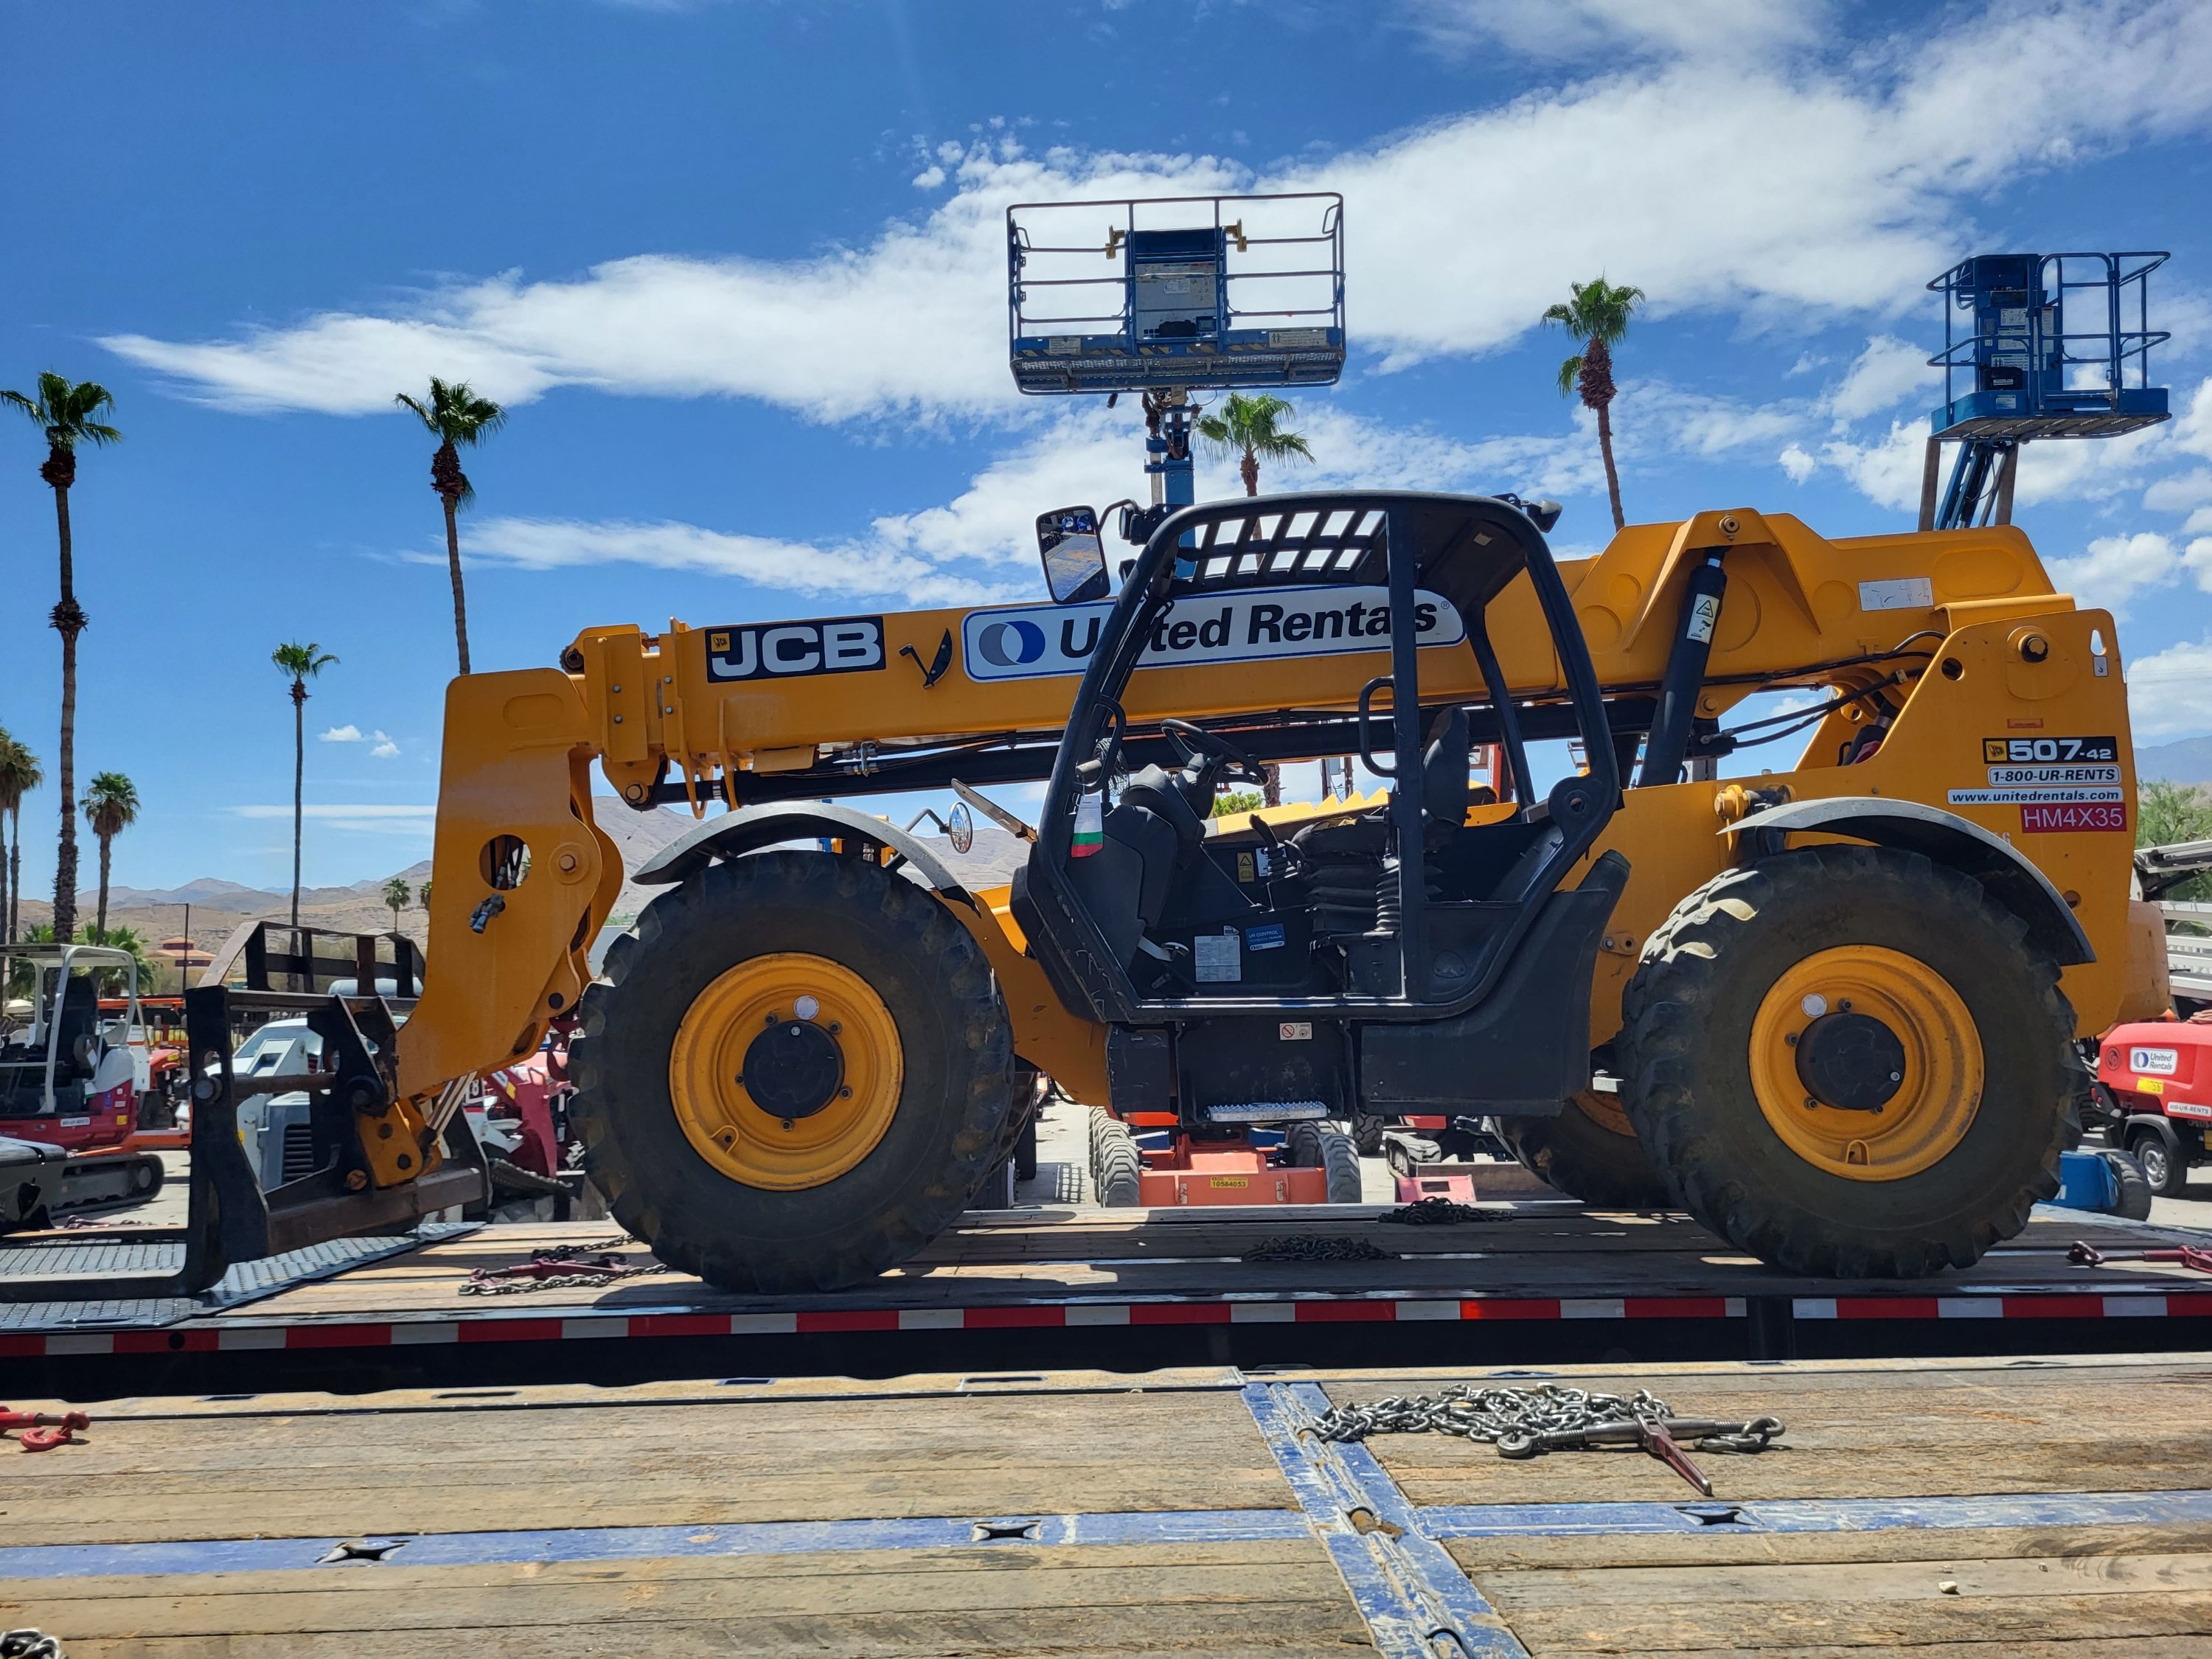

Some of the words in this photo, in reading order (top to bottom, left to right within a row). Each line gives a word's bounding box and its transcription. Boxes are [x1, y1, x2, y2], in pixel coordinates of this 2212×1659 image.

[1060, 607, 1233, 658] Uted
[1247, 601, 1438, 644] Rentas
[712, 622, 882, 677] JCB
[2008, 740, 2112, 761] 507-42
[1993, 768, 2115, 782] 1-800-UR-RENTS
[1952, 790, 2120, 802] www.unitedrentals.com
[2023, 807, 2124, 829] HM4X35
[2149, 1053, 2172, 1062] United
[2149, 1061, 2173, 1070] Rentals
